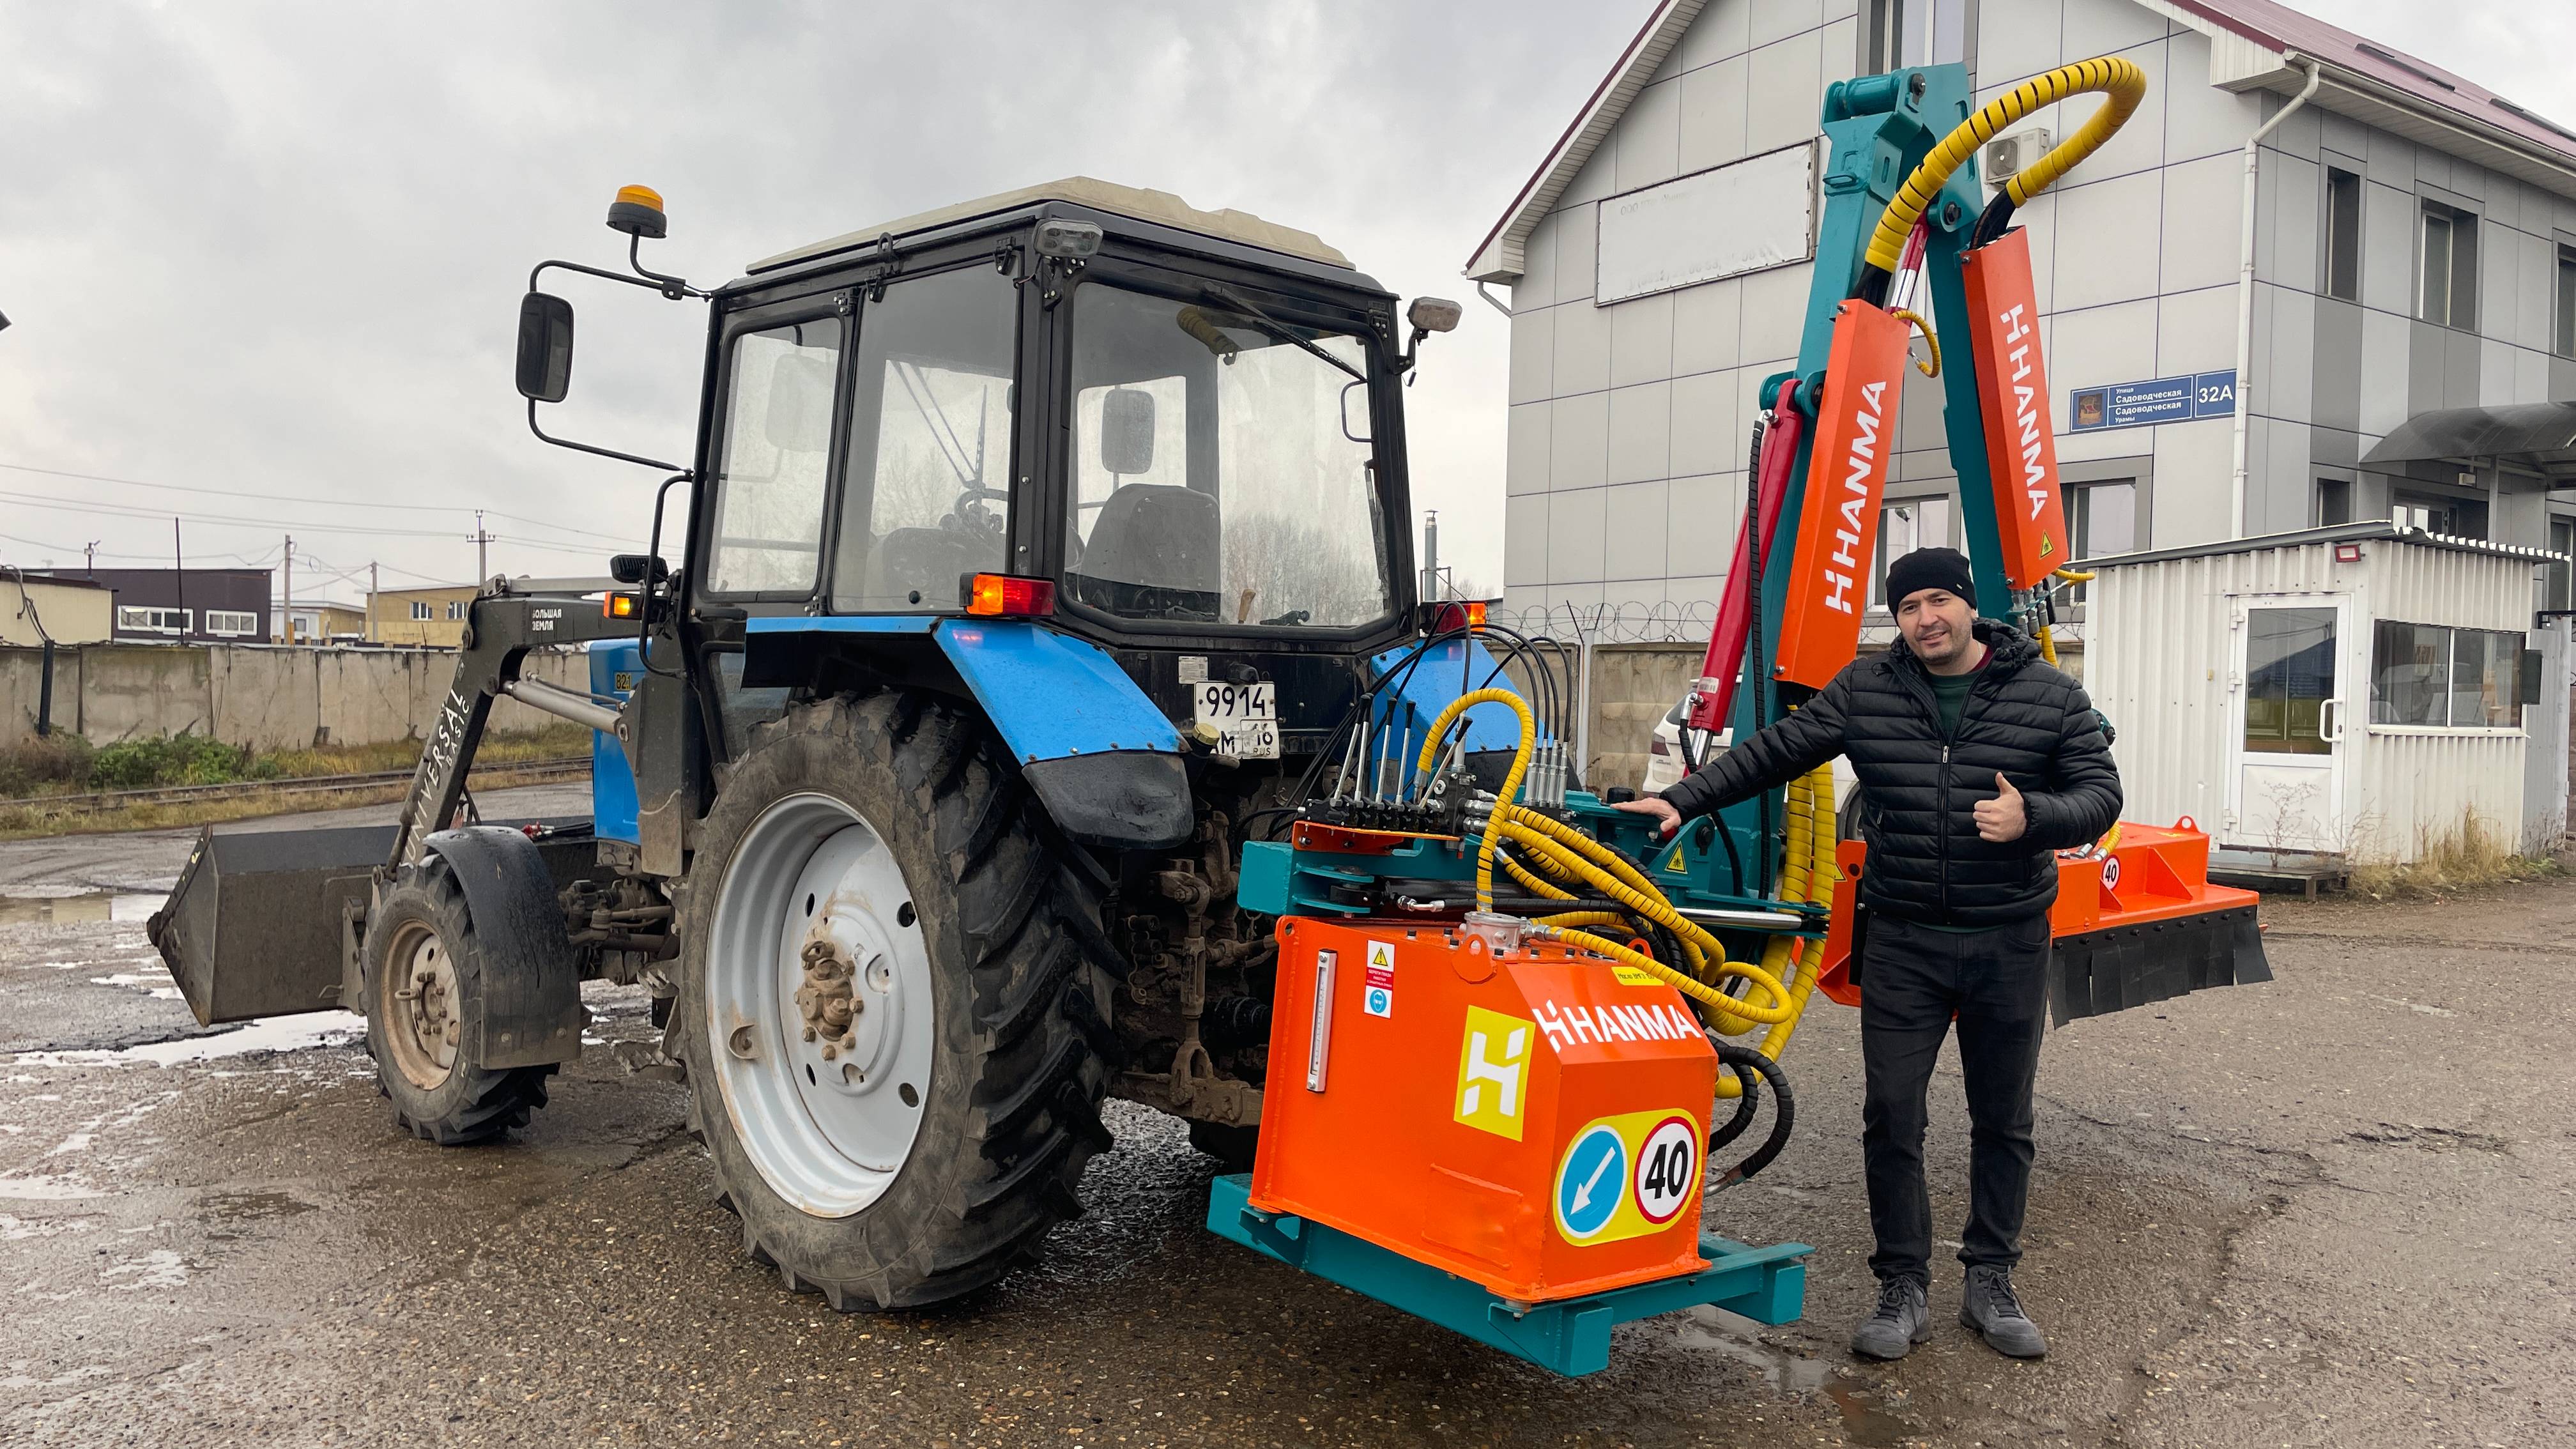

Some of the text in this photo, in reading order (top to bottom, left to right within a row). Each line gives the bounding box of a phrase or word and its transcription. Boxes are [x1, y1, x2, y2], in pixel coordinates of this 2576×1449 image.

[2115, 390, 2182, 403] Садоводческая
[2115, 402, 2181, 415] Садоводческая
[2198, 385, 2233, 403] 32А
[2009, 343, 2048, 522] HANMA
[1832, 381, 1887, 569] HANMA
[532, 620, 554, 631] ЗЕМЛЯ
[1206, 686, 1266, 717] 9914
[446, 700, 470, 767] BASIC
[1253, 747, 1271, 756] RUS
[405, 688, 464, 861] UNIVERSAL
[2105, 864, 2117, 882] 40
[1563, 1004, 1703, 1044] HANMA
[1644, 1140, 1689, 1200] 40
